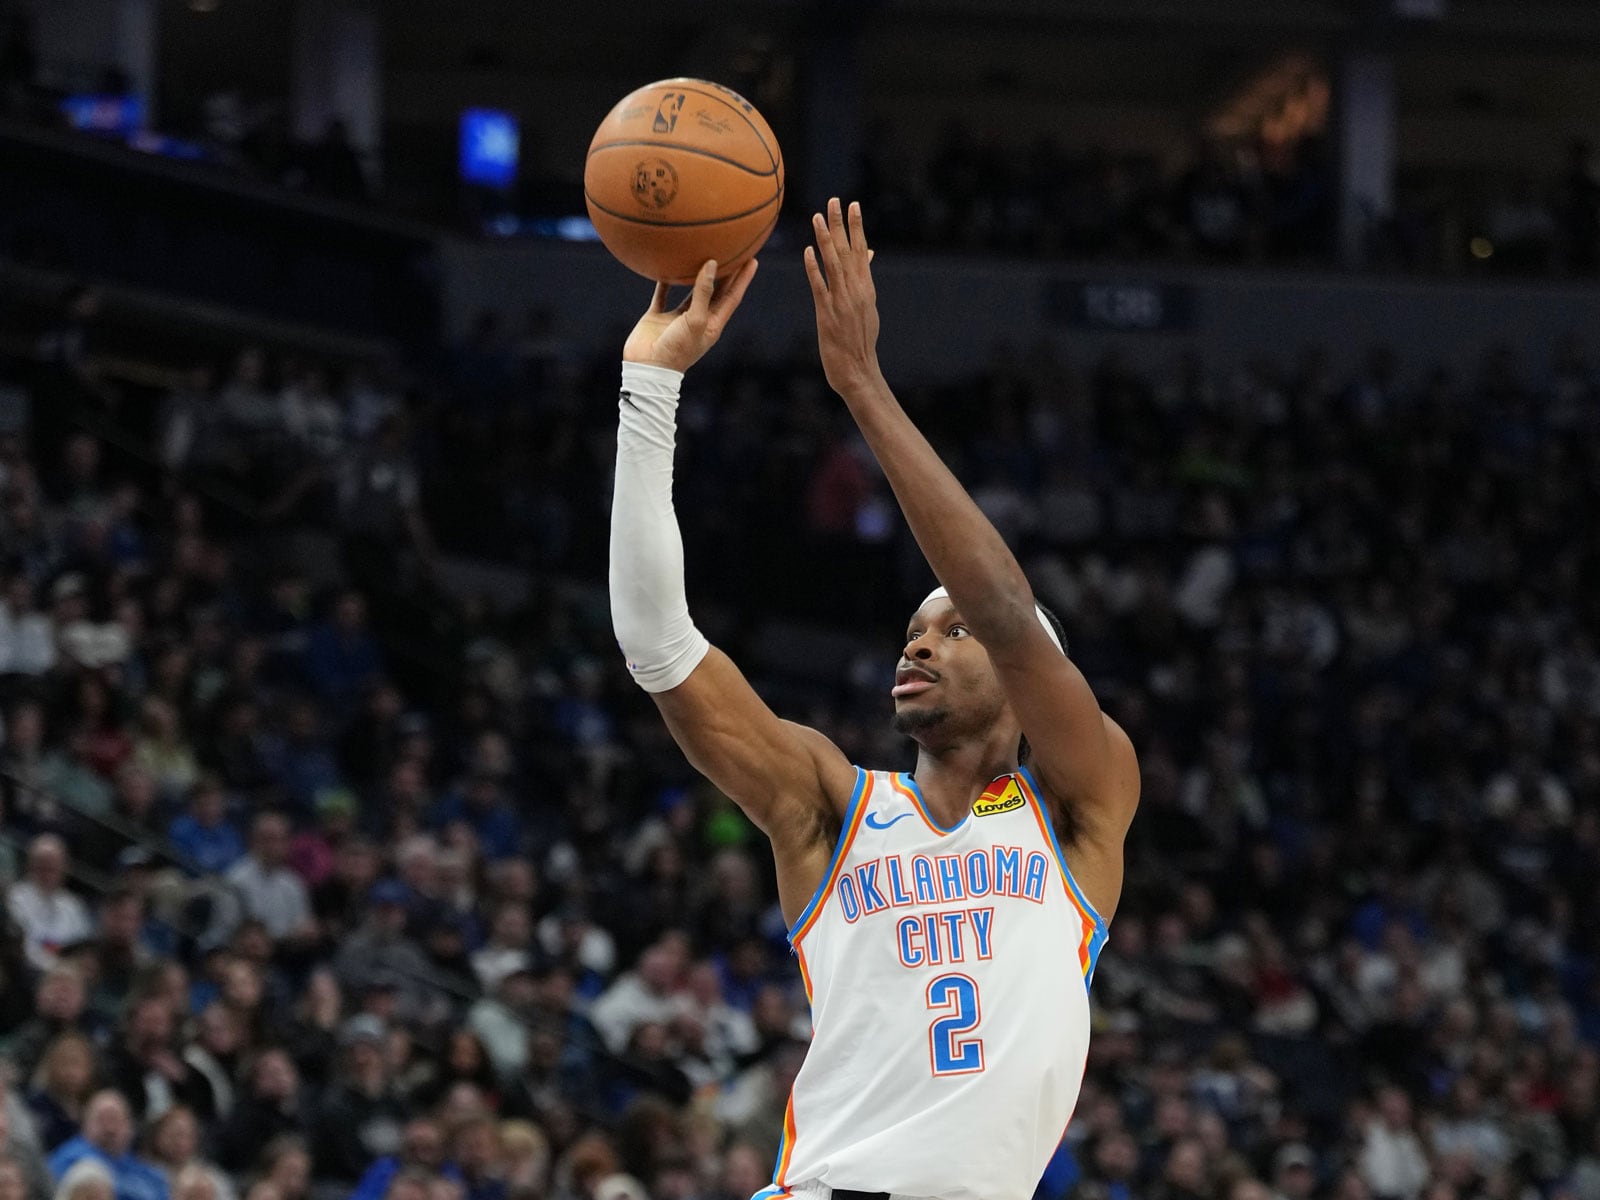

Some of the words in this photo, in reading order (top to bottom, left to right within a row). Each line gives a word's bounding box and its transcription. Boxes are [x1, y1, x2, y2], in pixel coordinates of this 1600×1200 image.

[838, 845, 1049, 924] OKLAHOMA
[896, 907, 994, 968] CITY
[926, 972, 985, 1077] 2
